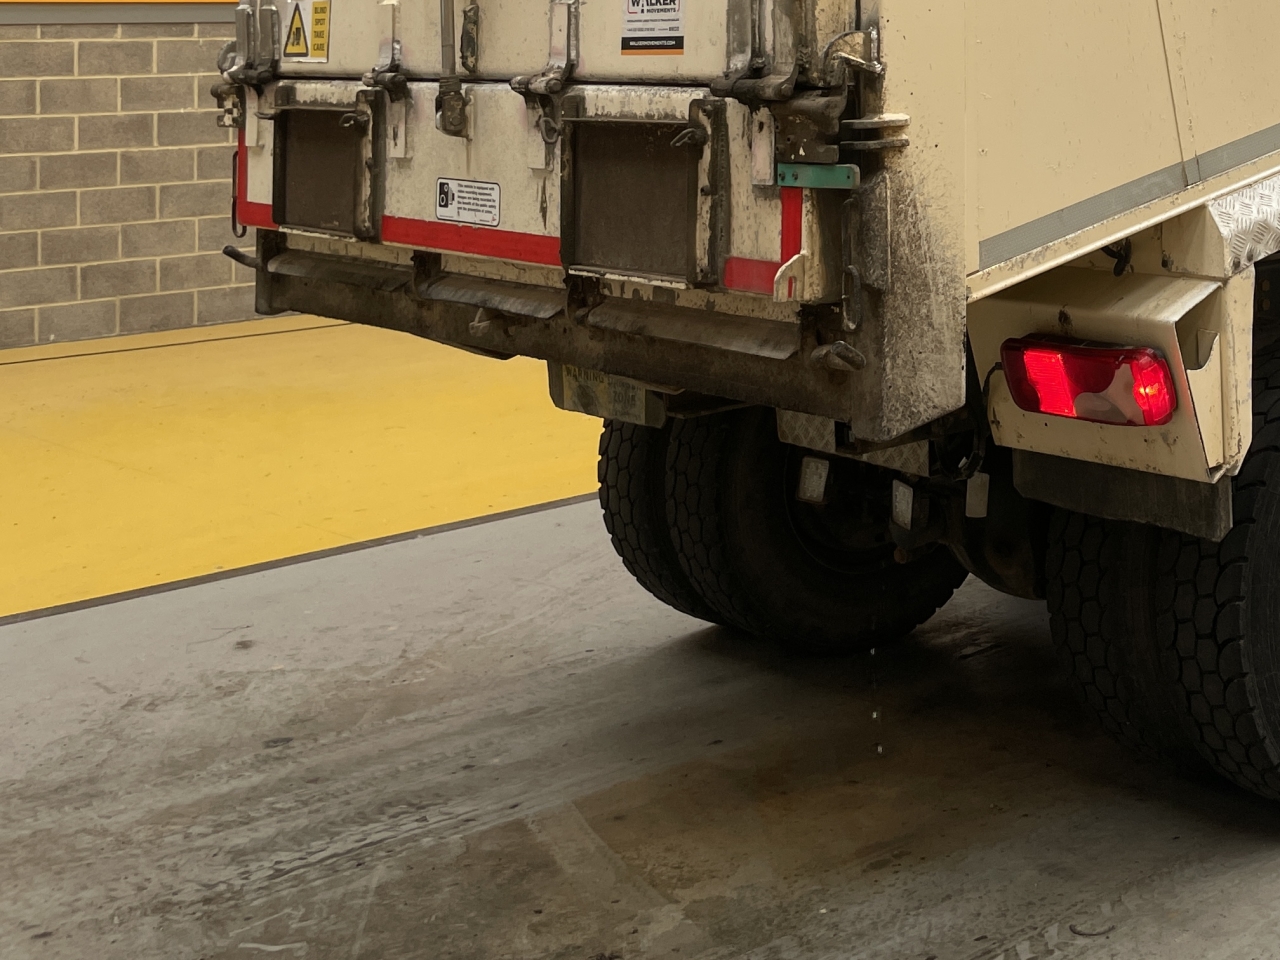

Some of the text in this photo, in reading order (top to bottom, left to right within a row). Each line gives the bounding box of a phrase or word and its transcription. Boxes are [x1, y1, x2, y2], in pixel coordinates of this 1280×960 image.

[314, 6, 327, 15] BLIND
[314, 18, 326, 26] SPOT
[314, 30, 325, 39] TAKE
[313, 43, 325, 51] CARE
